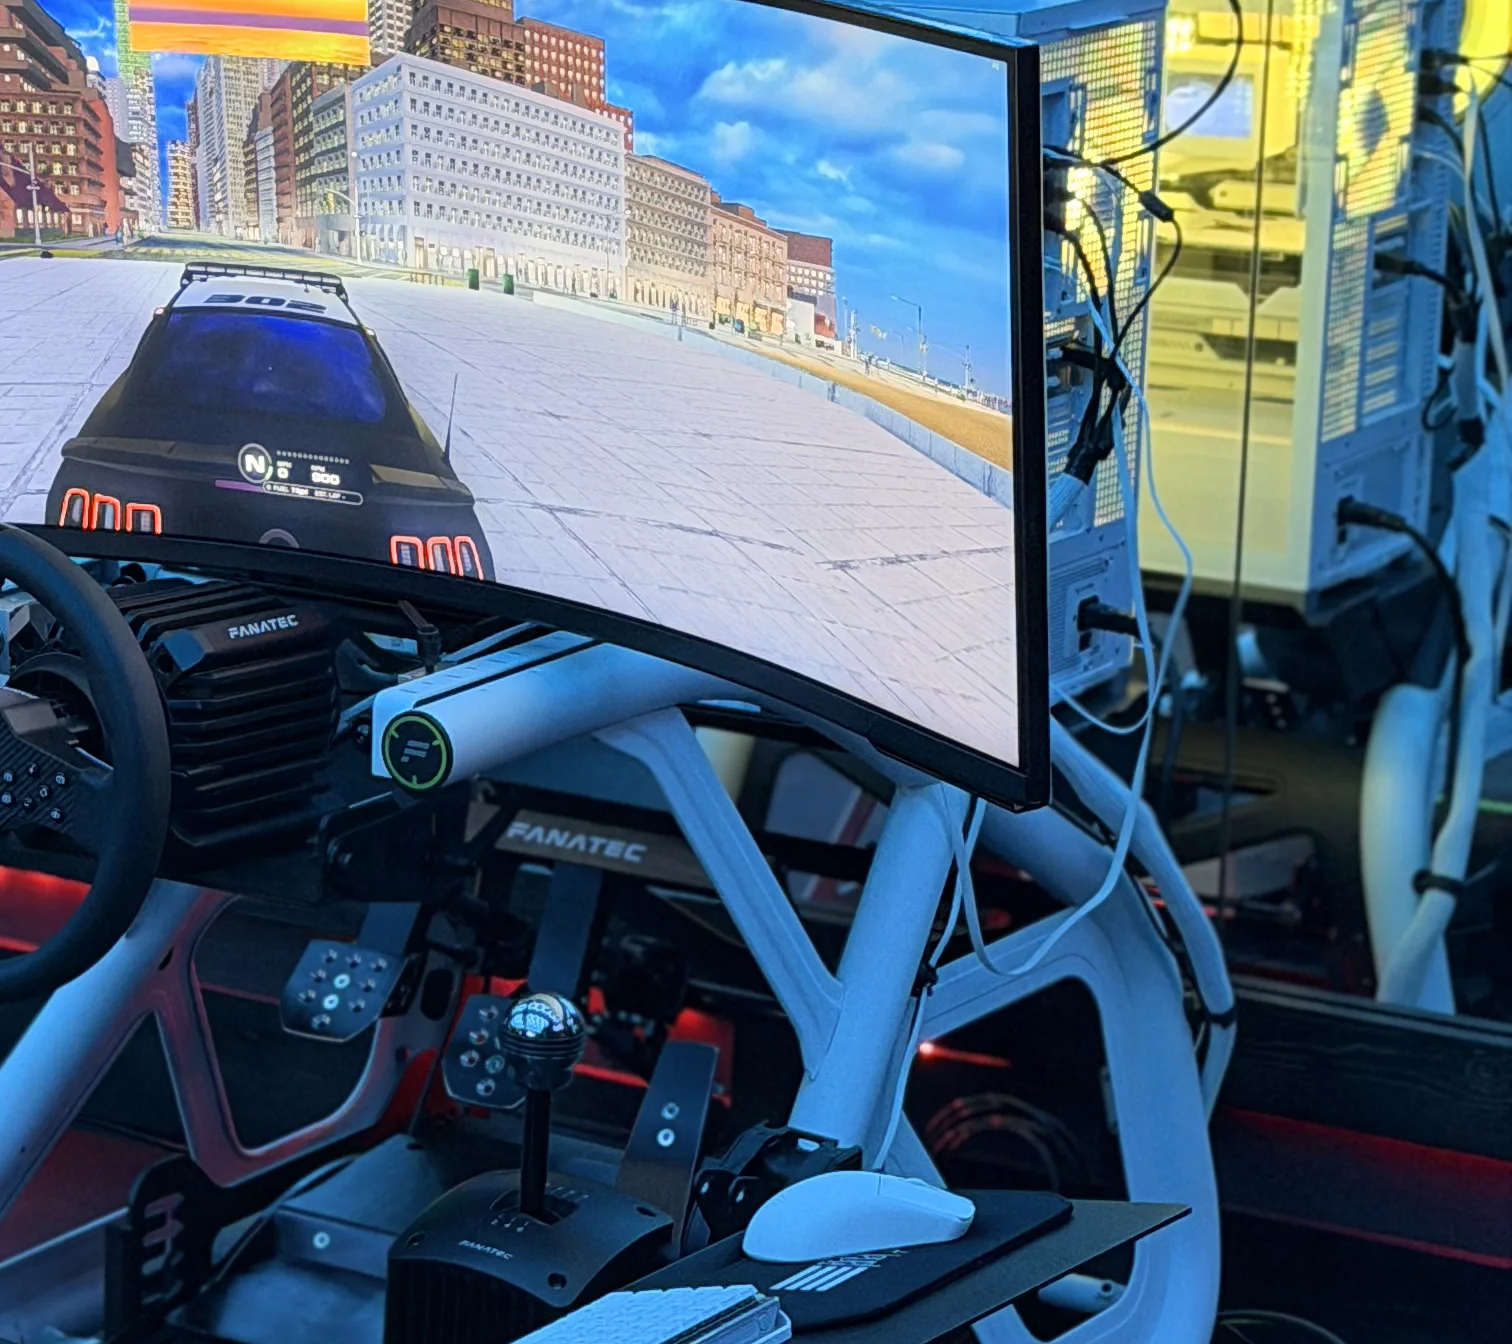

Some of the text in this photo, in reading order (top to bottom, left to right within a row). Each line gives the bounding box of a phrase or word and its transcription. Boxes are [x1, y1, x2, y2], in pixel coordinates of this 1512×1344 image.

[244, 453, 266, 474] N
[227, 614, 299, 639] FANATEC
[506, 820, 648, 864] FANATEC
[457, 1239, 514, 1260] FANATEC
